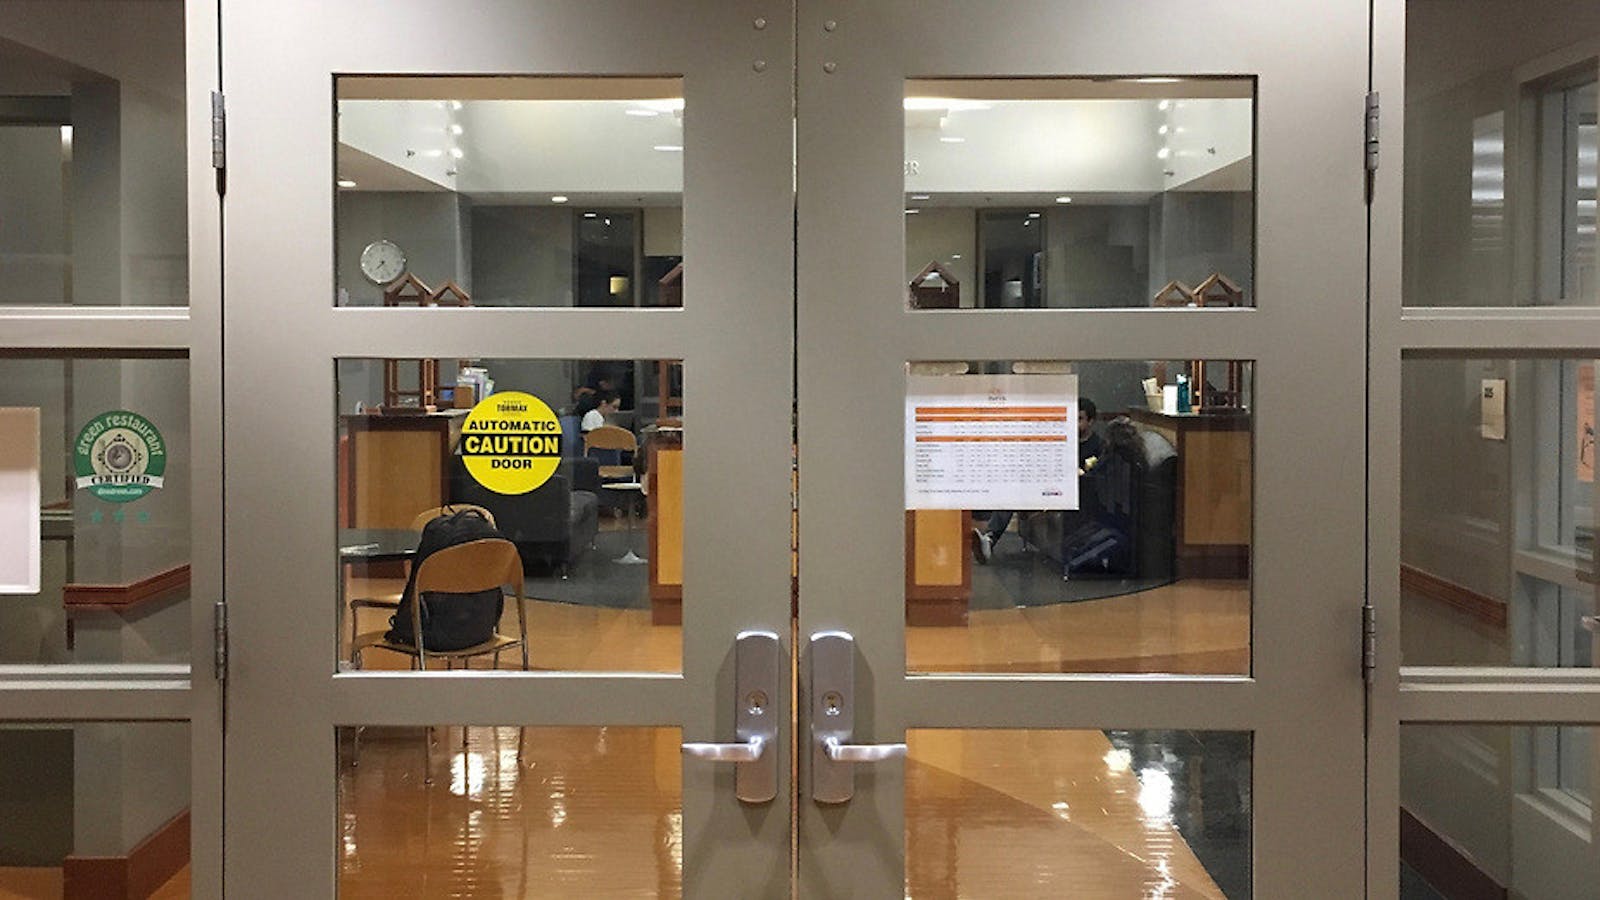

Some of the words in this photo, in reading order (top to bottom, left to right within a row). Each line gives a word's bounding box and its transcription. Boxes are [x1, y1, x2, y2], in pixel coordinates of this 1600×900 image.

[469, 420, 556, 431] AUTOMATIC
[77, 420, 105, 456] green
[106, 414, 163, 456] restaurant
[465, 435, 559, 454] CAUTION
[491, 459, 532, 469] DOOR
[91, 474, 151, 485] CERTIFIED
